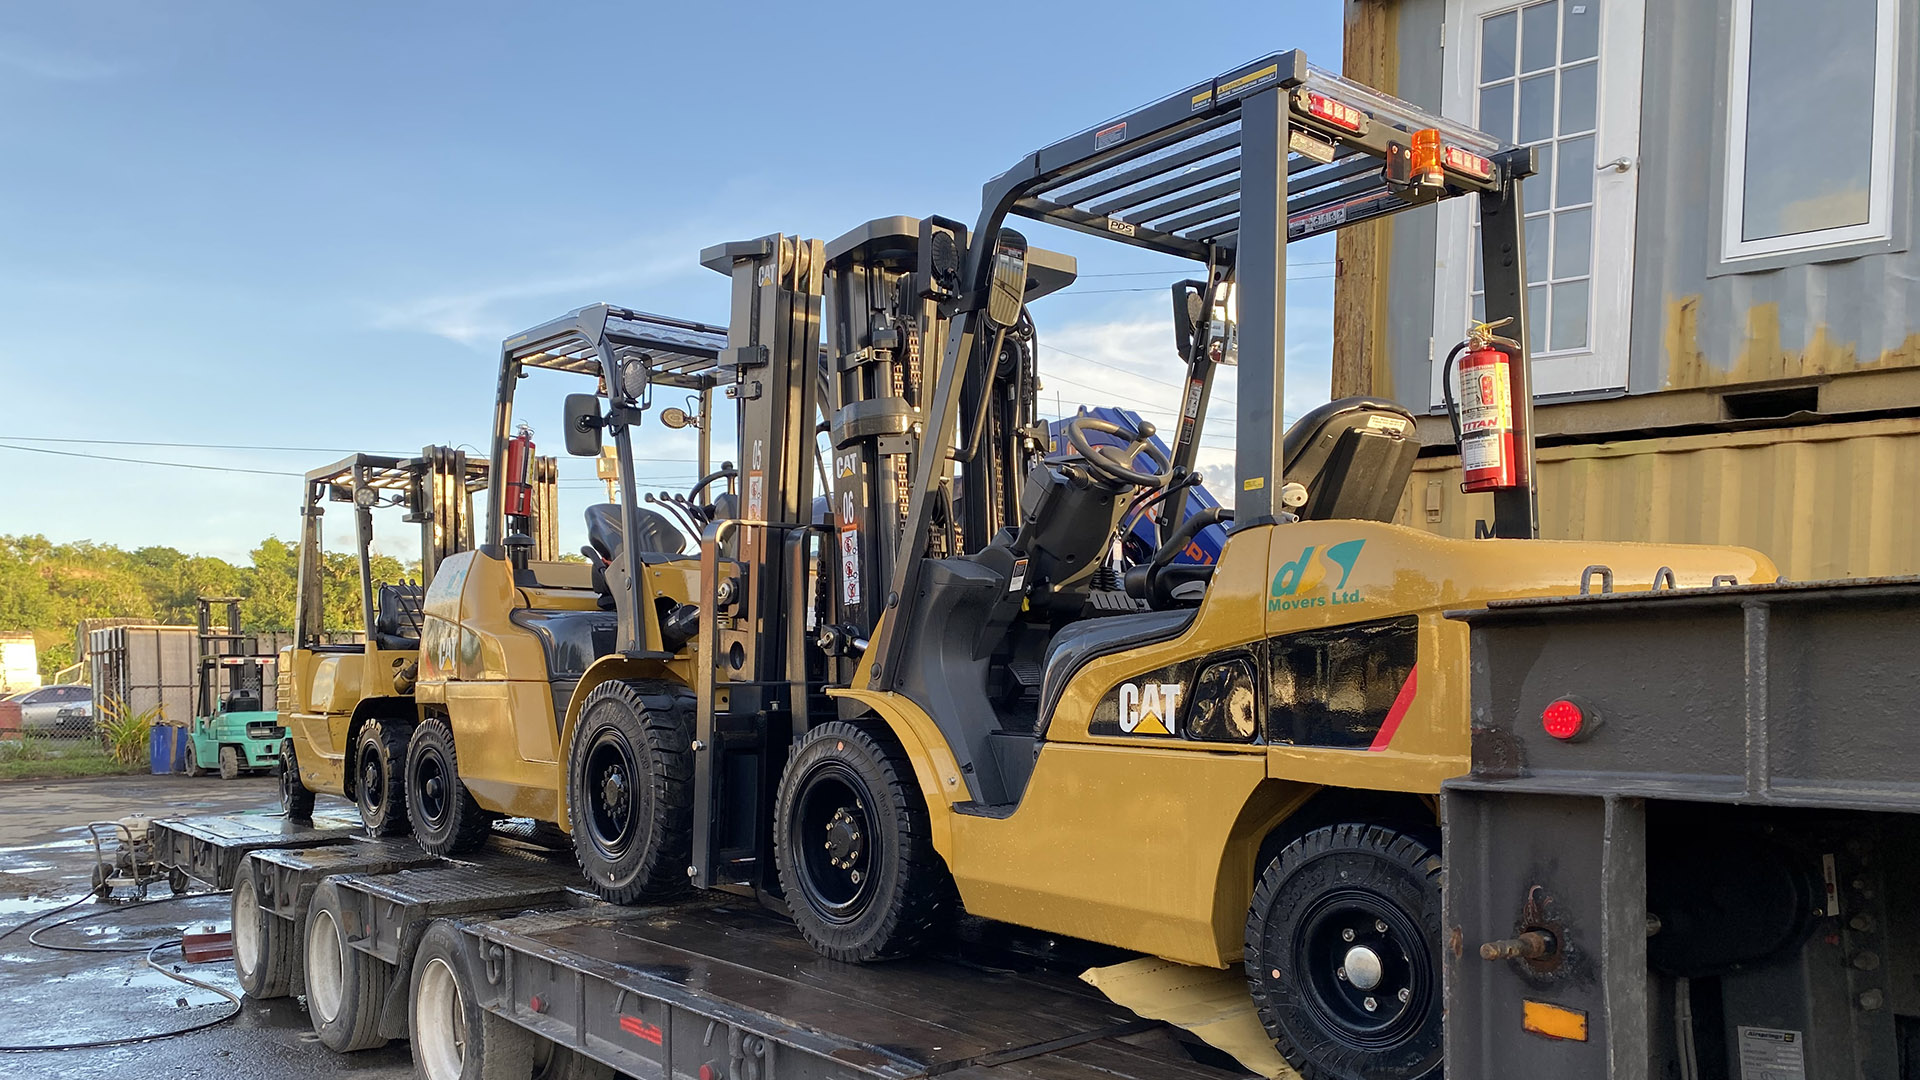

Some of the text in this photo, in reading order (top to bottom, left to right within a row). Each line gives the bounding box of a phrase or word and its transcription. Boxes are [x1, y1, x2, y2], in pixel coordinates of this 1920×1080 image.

[1110, 220, 1133, 233] PDS
[758, 263, 776, 287] CAT
[1462, 416, 1498, 433] TITAN
[752, 439, 762, 471] 05
[836, 452, 857, 479] CAT
[842, 490, 855, 525] 06
[1268, 588, 1365, 612] Movers Ltd.
[438, 637, 458, 670] CAT
[1119, 682, 1181, 735] CAT
